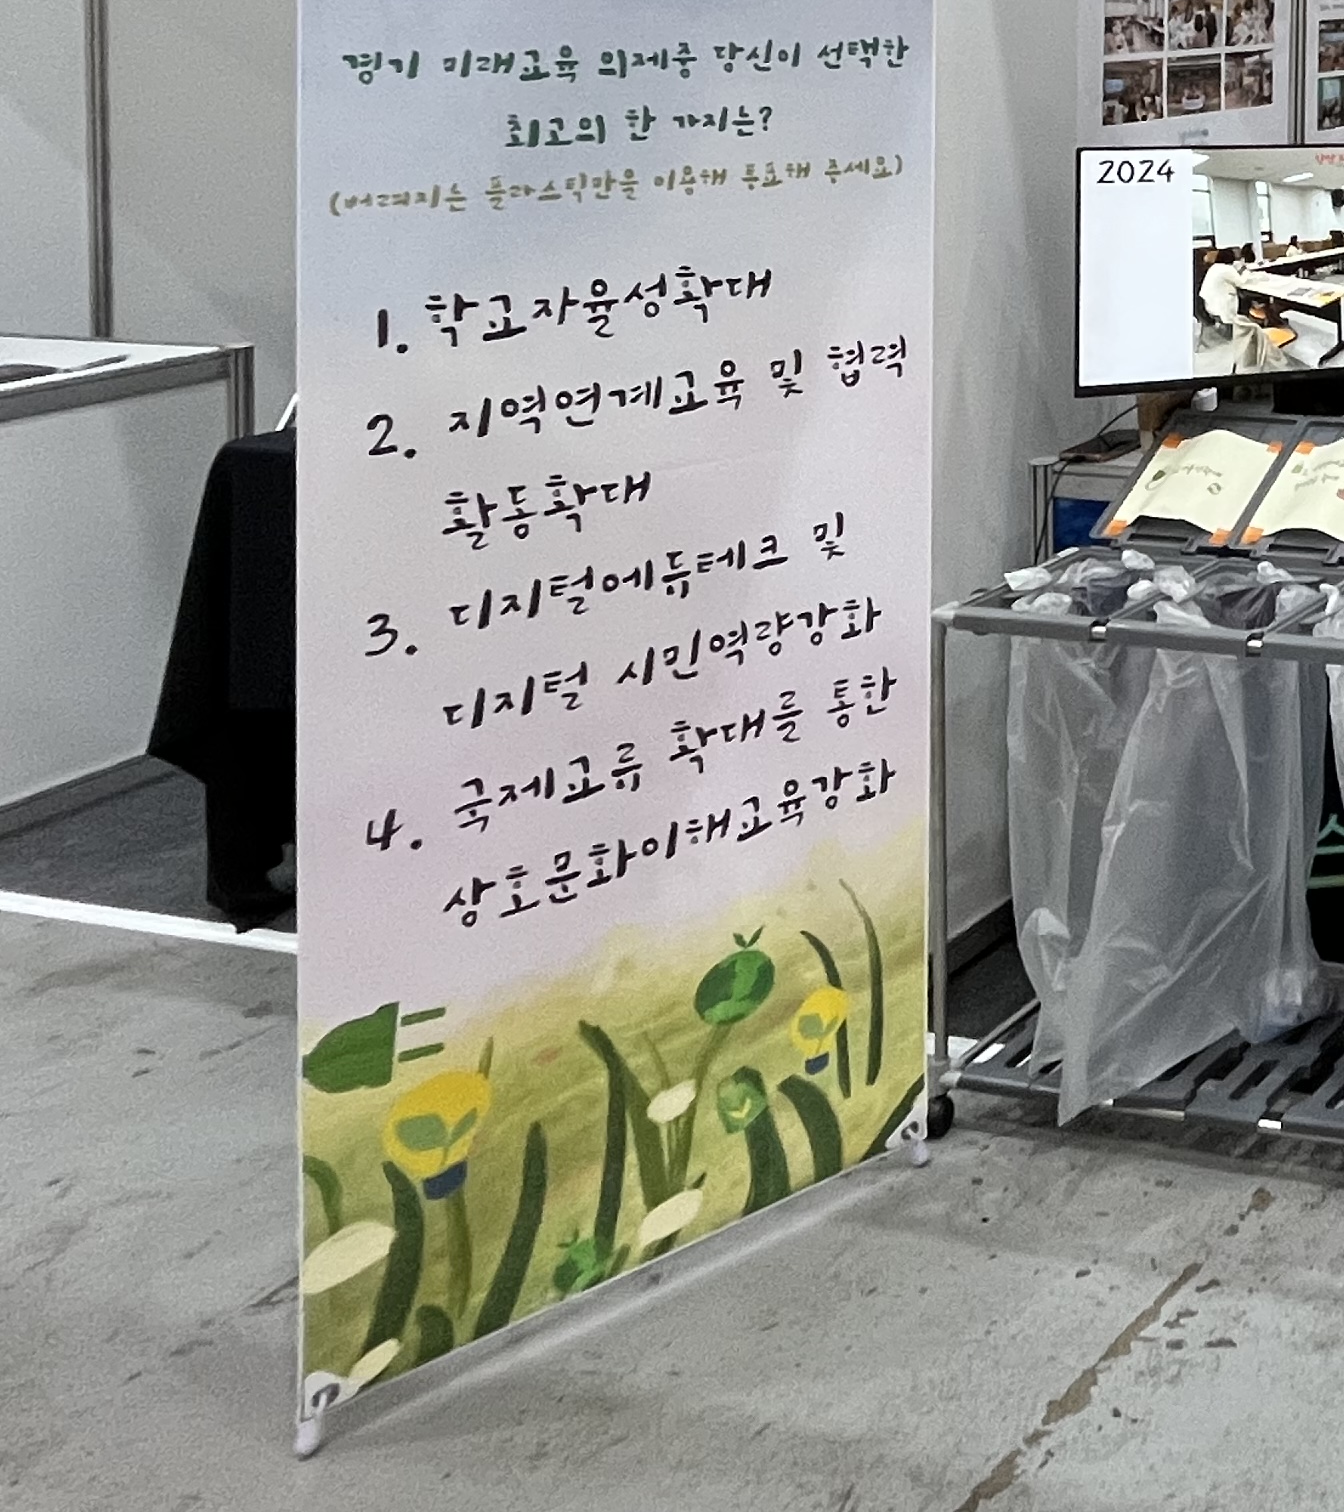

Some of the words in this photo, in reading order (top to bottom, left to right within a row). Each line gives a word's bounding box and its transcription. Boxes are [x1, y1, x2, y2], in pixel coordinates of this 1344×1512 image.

[343, 50, 419, 84] 경기
[443, 45, 580, 82] 미래교육
[715, 40, 801, 75] 당신이
[817, 37, 909, 70] 선택한
[506, 113, 605, 148] 최고의
[625, 105, 656, 141] 한
[673, 105, 773, 138] 가지는?
[654, 166, 727, 196] 이용해
[741, 160, 811, 189] 투표해
[824, 154, 903, 184] 주세요)
[1097, 159, 1175, 184] 2024
[378, 309, 409, 354] 1.
[425, 266, 771, 347] 학교자율성확대
[367, 415, 417, 458] 2.
[449, 360, 744, 438] 지역연계교육
[770, 351, 803, 398] 및
[827, 335, 907, 387] 협력
[442, 471, 651, 550] 활동확대
[365, 614, 418, 656] 3.
[450, 536, 788, 629] 디지털에듀테크
[814, 512, 844, 560] 및
[444, 662, 588, 727] 디지털
[617, 597, 881, 686] 시민역량강화
[367, 810, 422, 851] 4.
[455, 743, 642, 832] 국제교류
[670, 691, 803, 773] 확대를
[827, 666, 896, 728] 통한
[443, 759, 895, 927] 상호문화이해교육강화
